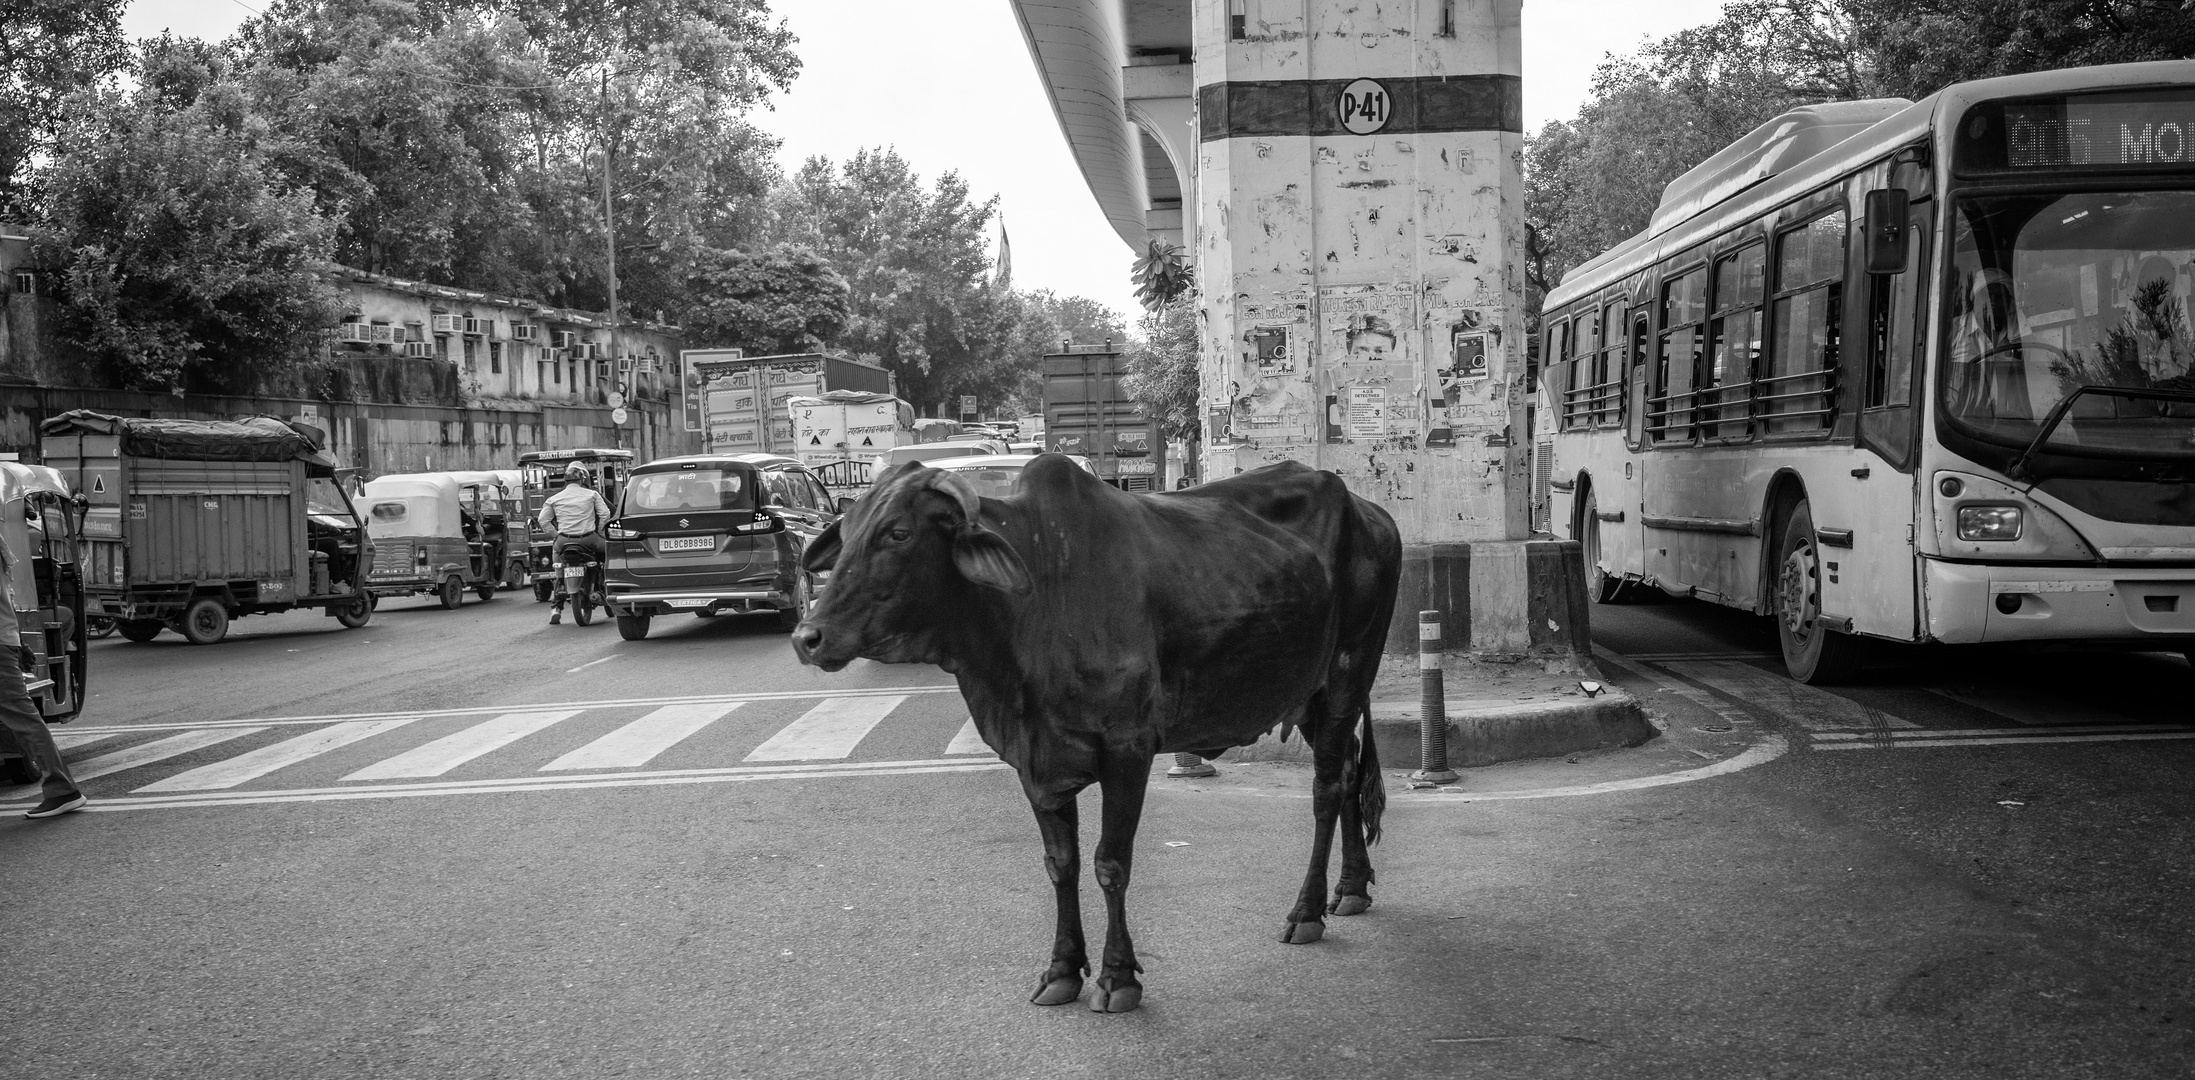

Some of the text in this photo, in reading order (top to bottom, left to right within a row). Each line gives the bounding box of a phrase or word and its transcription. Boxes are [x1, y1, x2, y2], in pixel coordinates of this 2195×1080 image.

[2012, 119, 2091, 166] 905
[1321, 294, 1412, 314] MUKESH RAPUT
[733, 372, 786, 387] राधे राधे
[735, 397, 752, 410] डाक
[204, 501, 219, 509] CNG
[664, 538, 713, 549] DL8CBB8986
